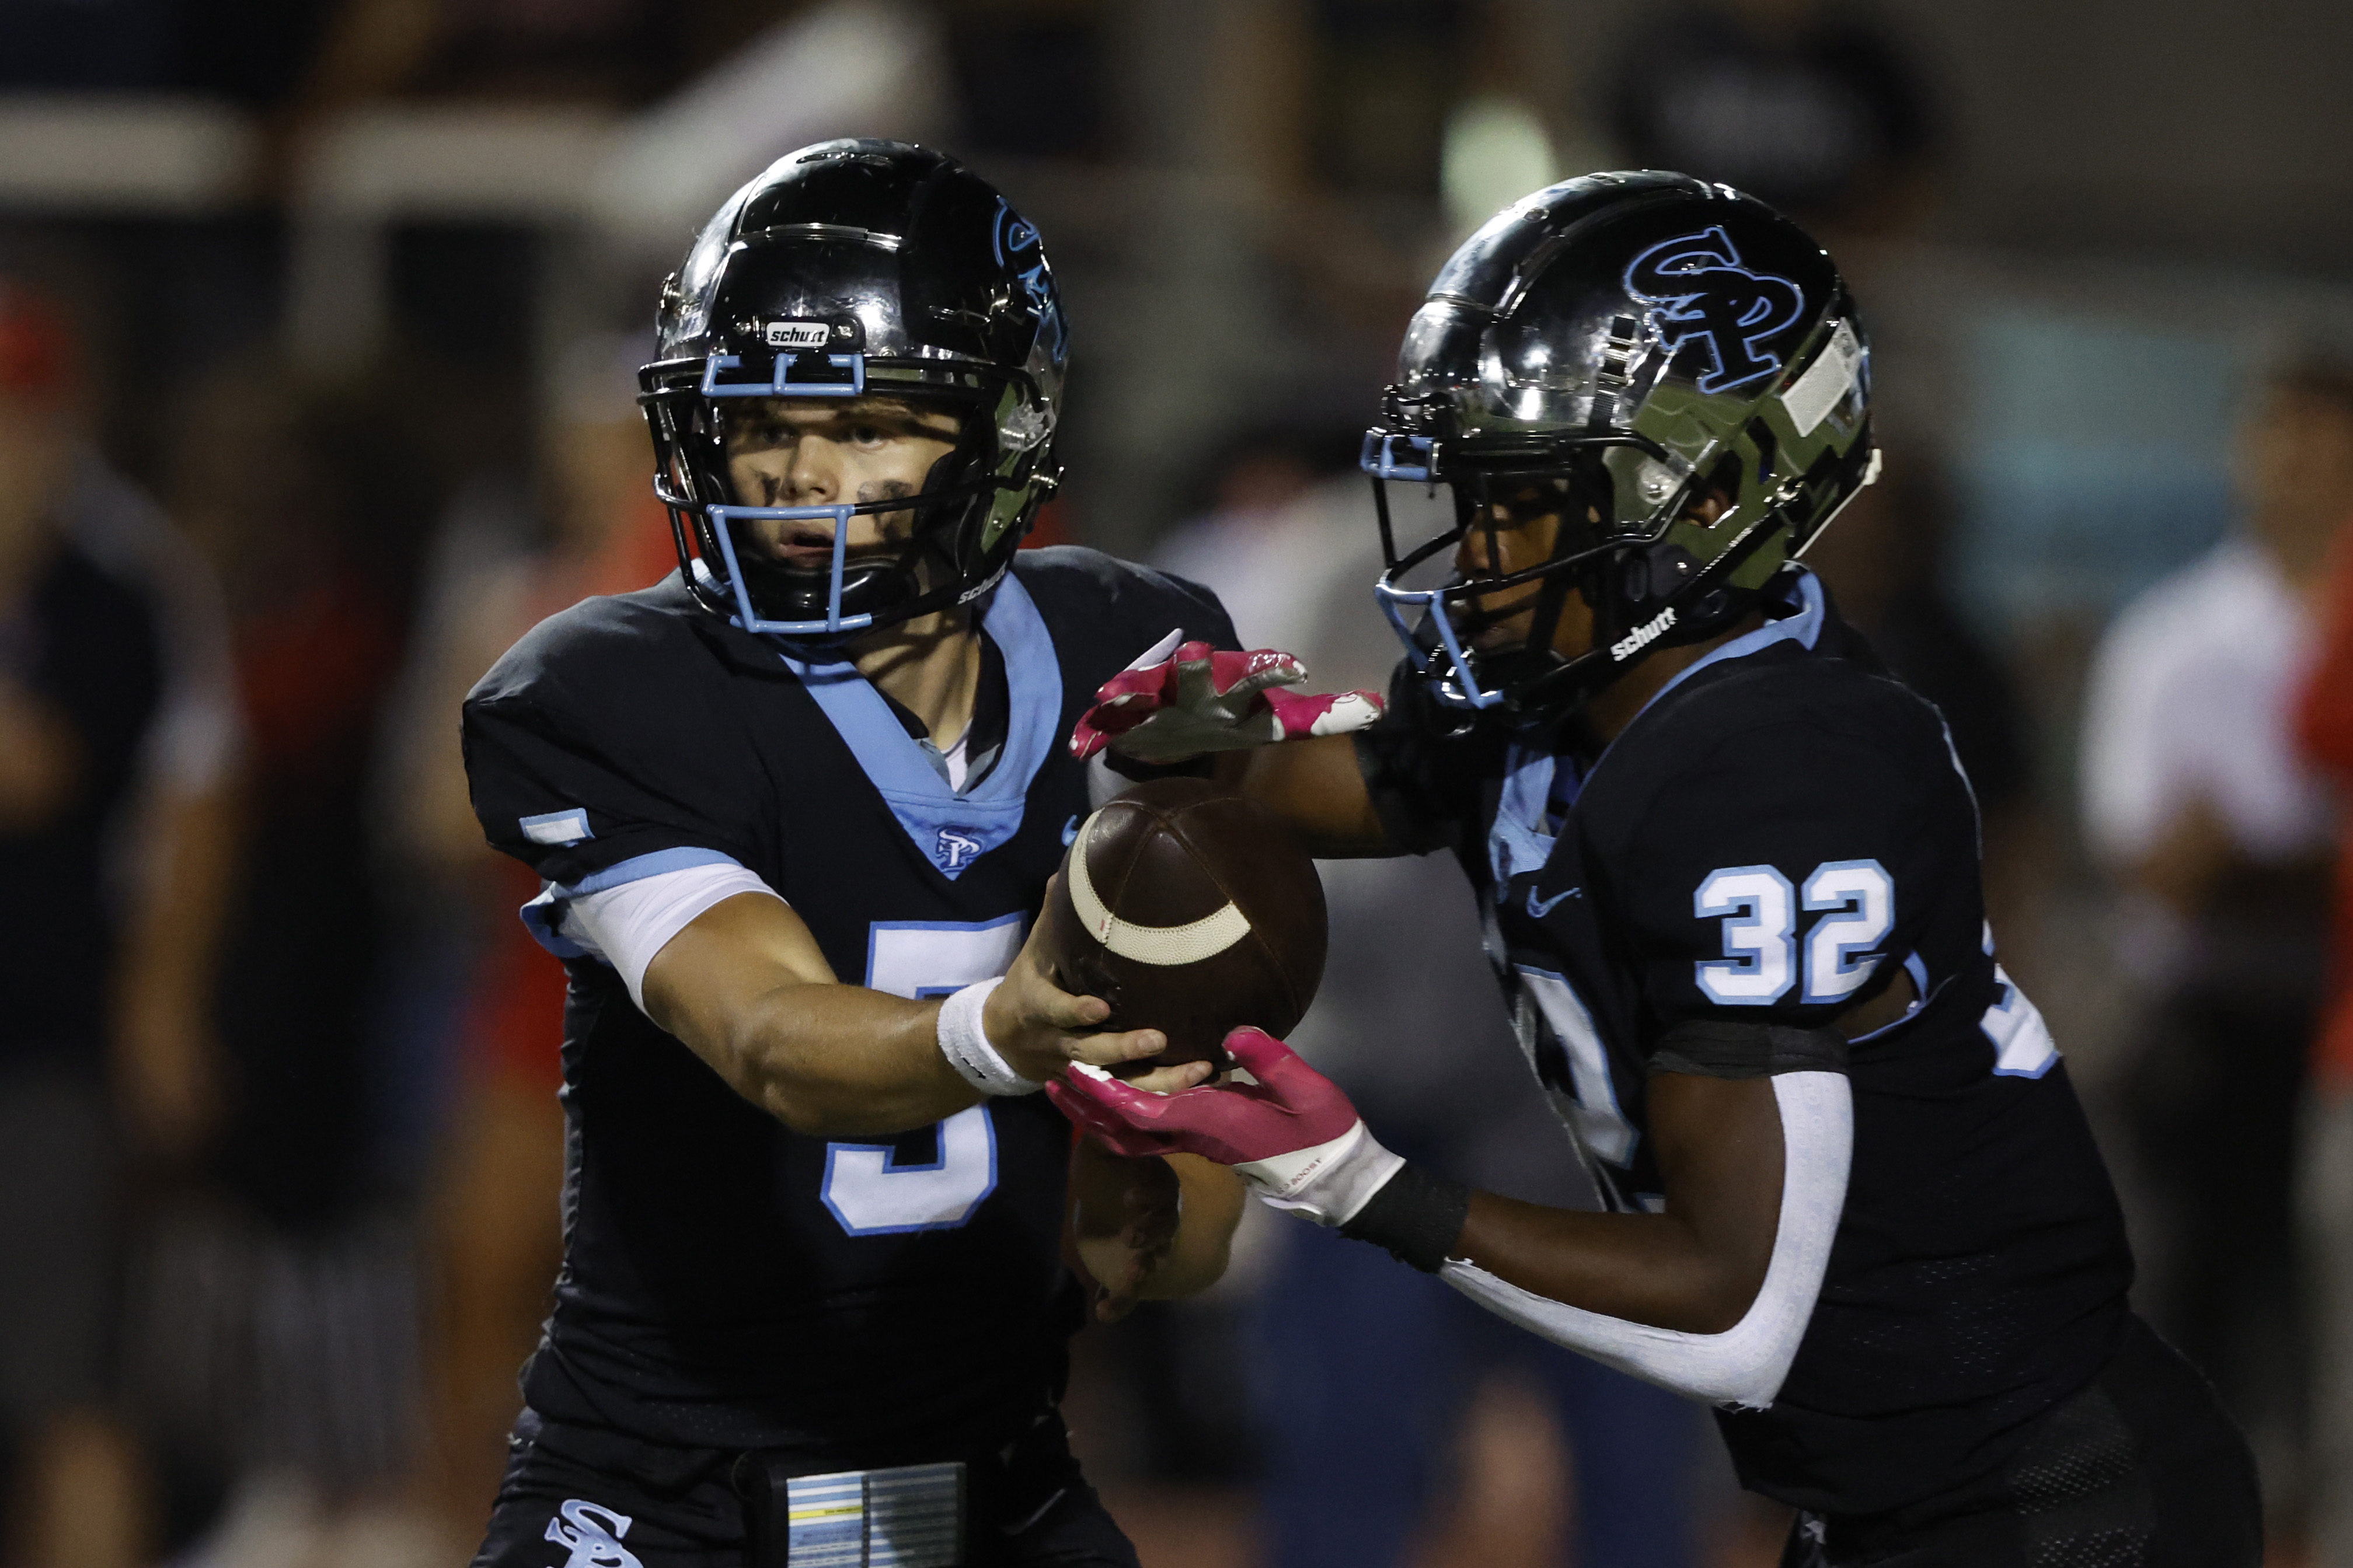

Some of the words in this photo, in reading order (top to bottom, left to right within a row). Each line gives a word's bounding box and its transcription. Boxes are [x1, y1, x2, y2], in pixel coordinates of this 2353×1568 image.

[957, 560, 1008, 605] sch
[1610, 606, 1678, 662] schutt
[1693, 858, 1895, 1005] 32
